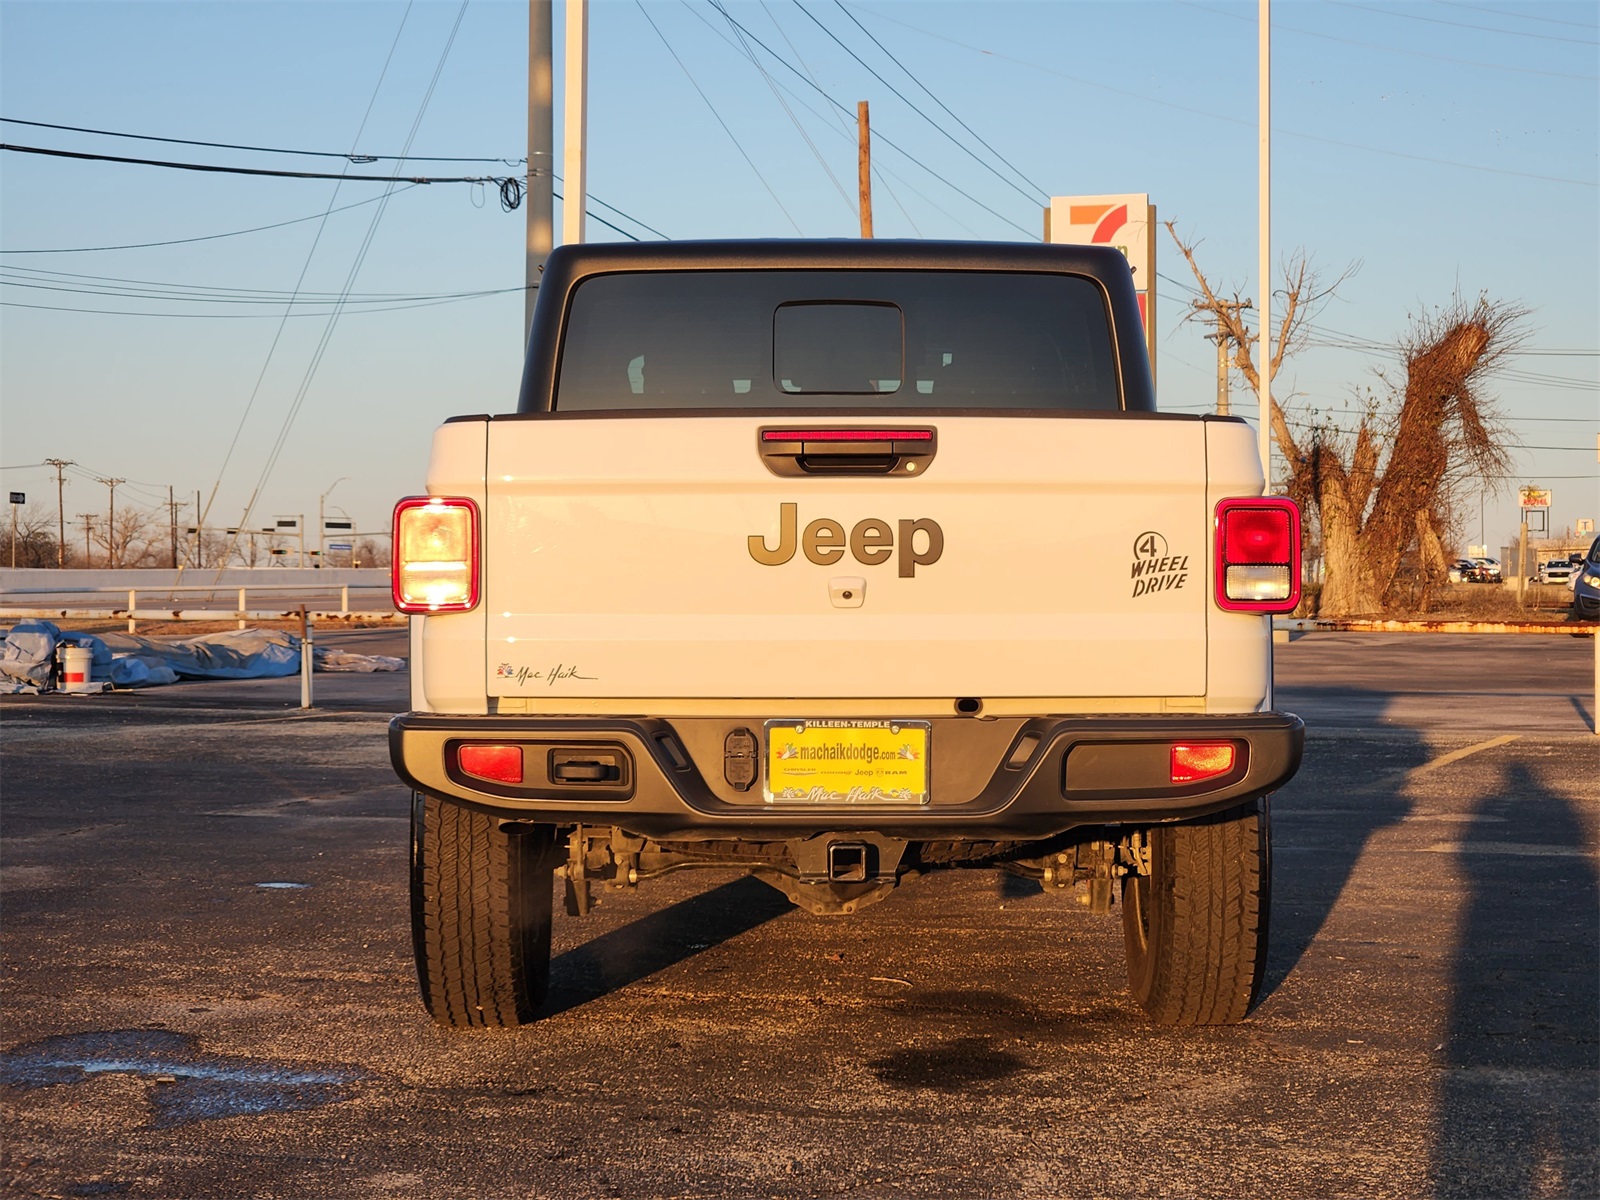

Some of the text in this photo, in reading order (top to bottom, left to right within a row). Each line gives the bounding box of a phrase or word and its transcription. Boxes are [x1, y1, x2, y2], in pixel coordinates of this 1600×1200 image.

[1070, 204, 1127, 243] 7
[748, 502, 944, 578] Jeep
[1139, 535, 1157, 557] 4
[1131, 555, 1189, 579] WHEEL
[1132, 573, 1188, 598] DRIVE
[516, 663, 598, 686] Mac Haik
[805, 720, 890, 729] KILLEEN-TEMPLE
[800, 743, 896, 764] machaikdodge.com
[854, 769, 874, 777] Jeep
[806, 786, 885, 803] Mac Haik
